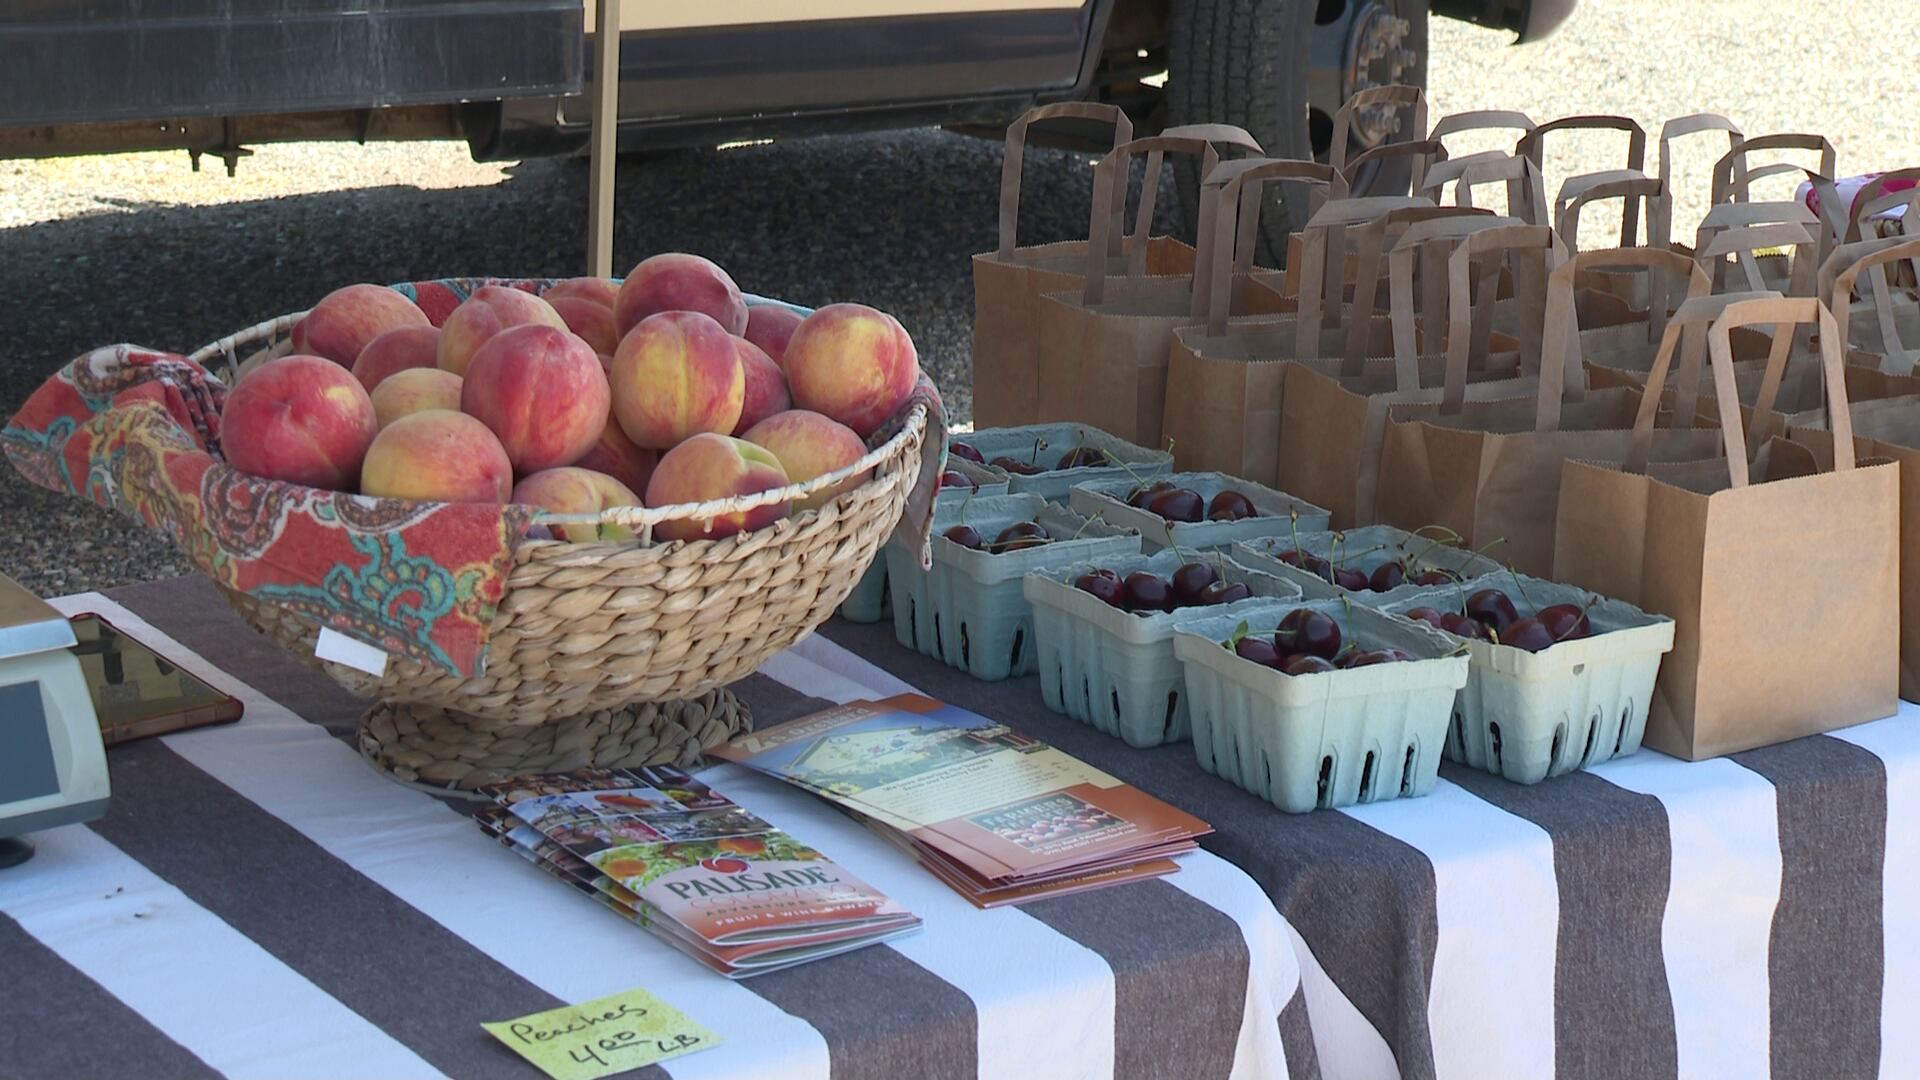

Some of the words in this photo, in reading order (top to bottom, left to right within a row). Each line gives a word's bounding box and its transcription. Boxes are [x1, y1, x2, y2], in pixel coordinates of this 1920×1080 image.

[664, 866, 840, 900] PALISADE
[510, 1004, 647, 1045] Peaches
[657, 1034, 701, 1054] LB
